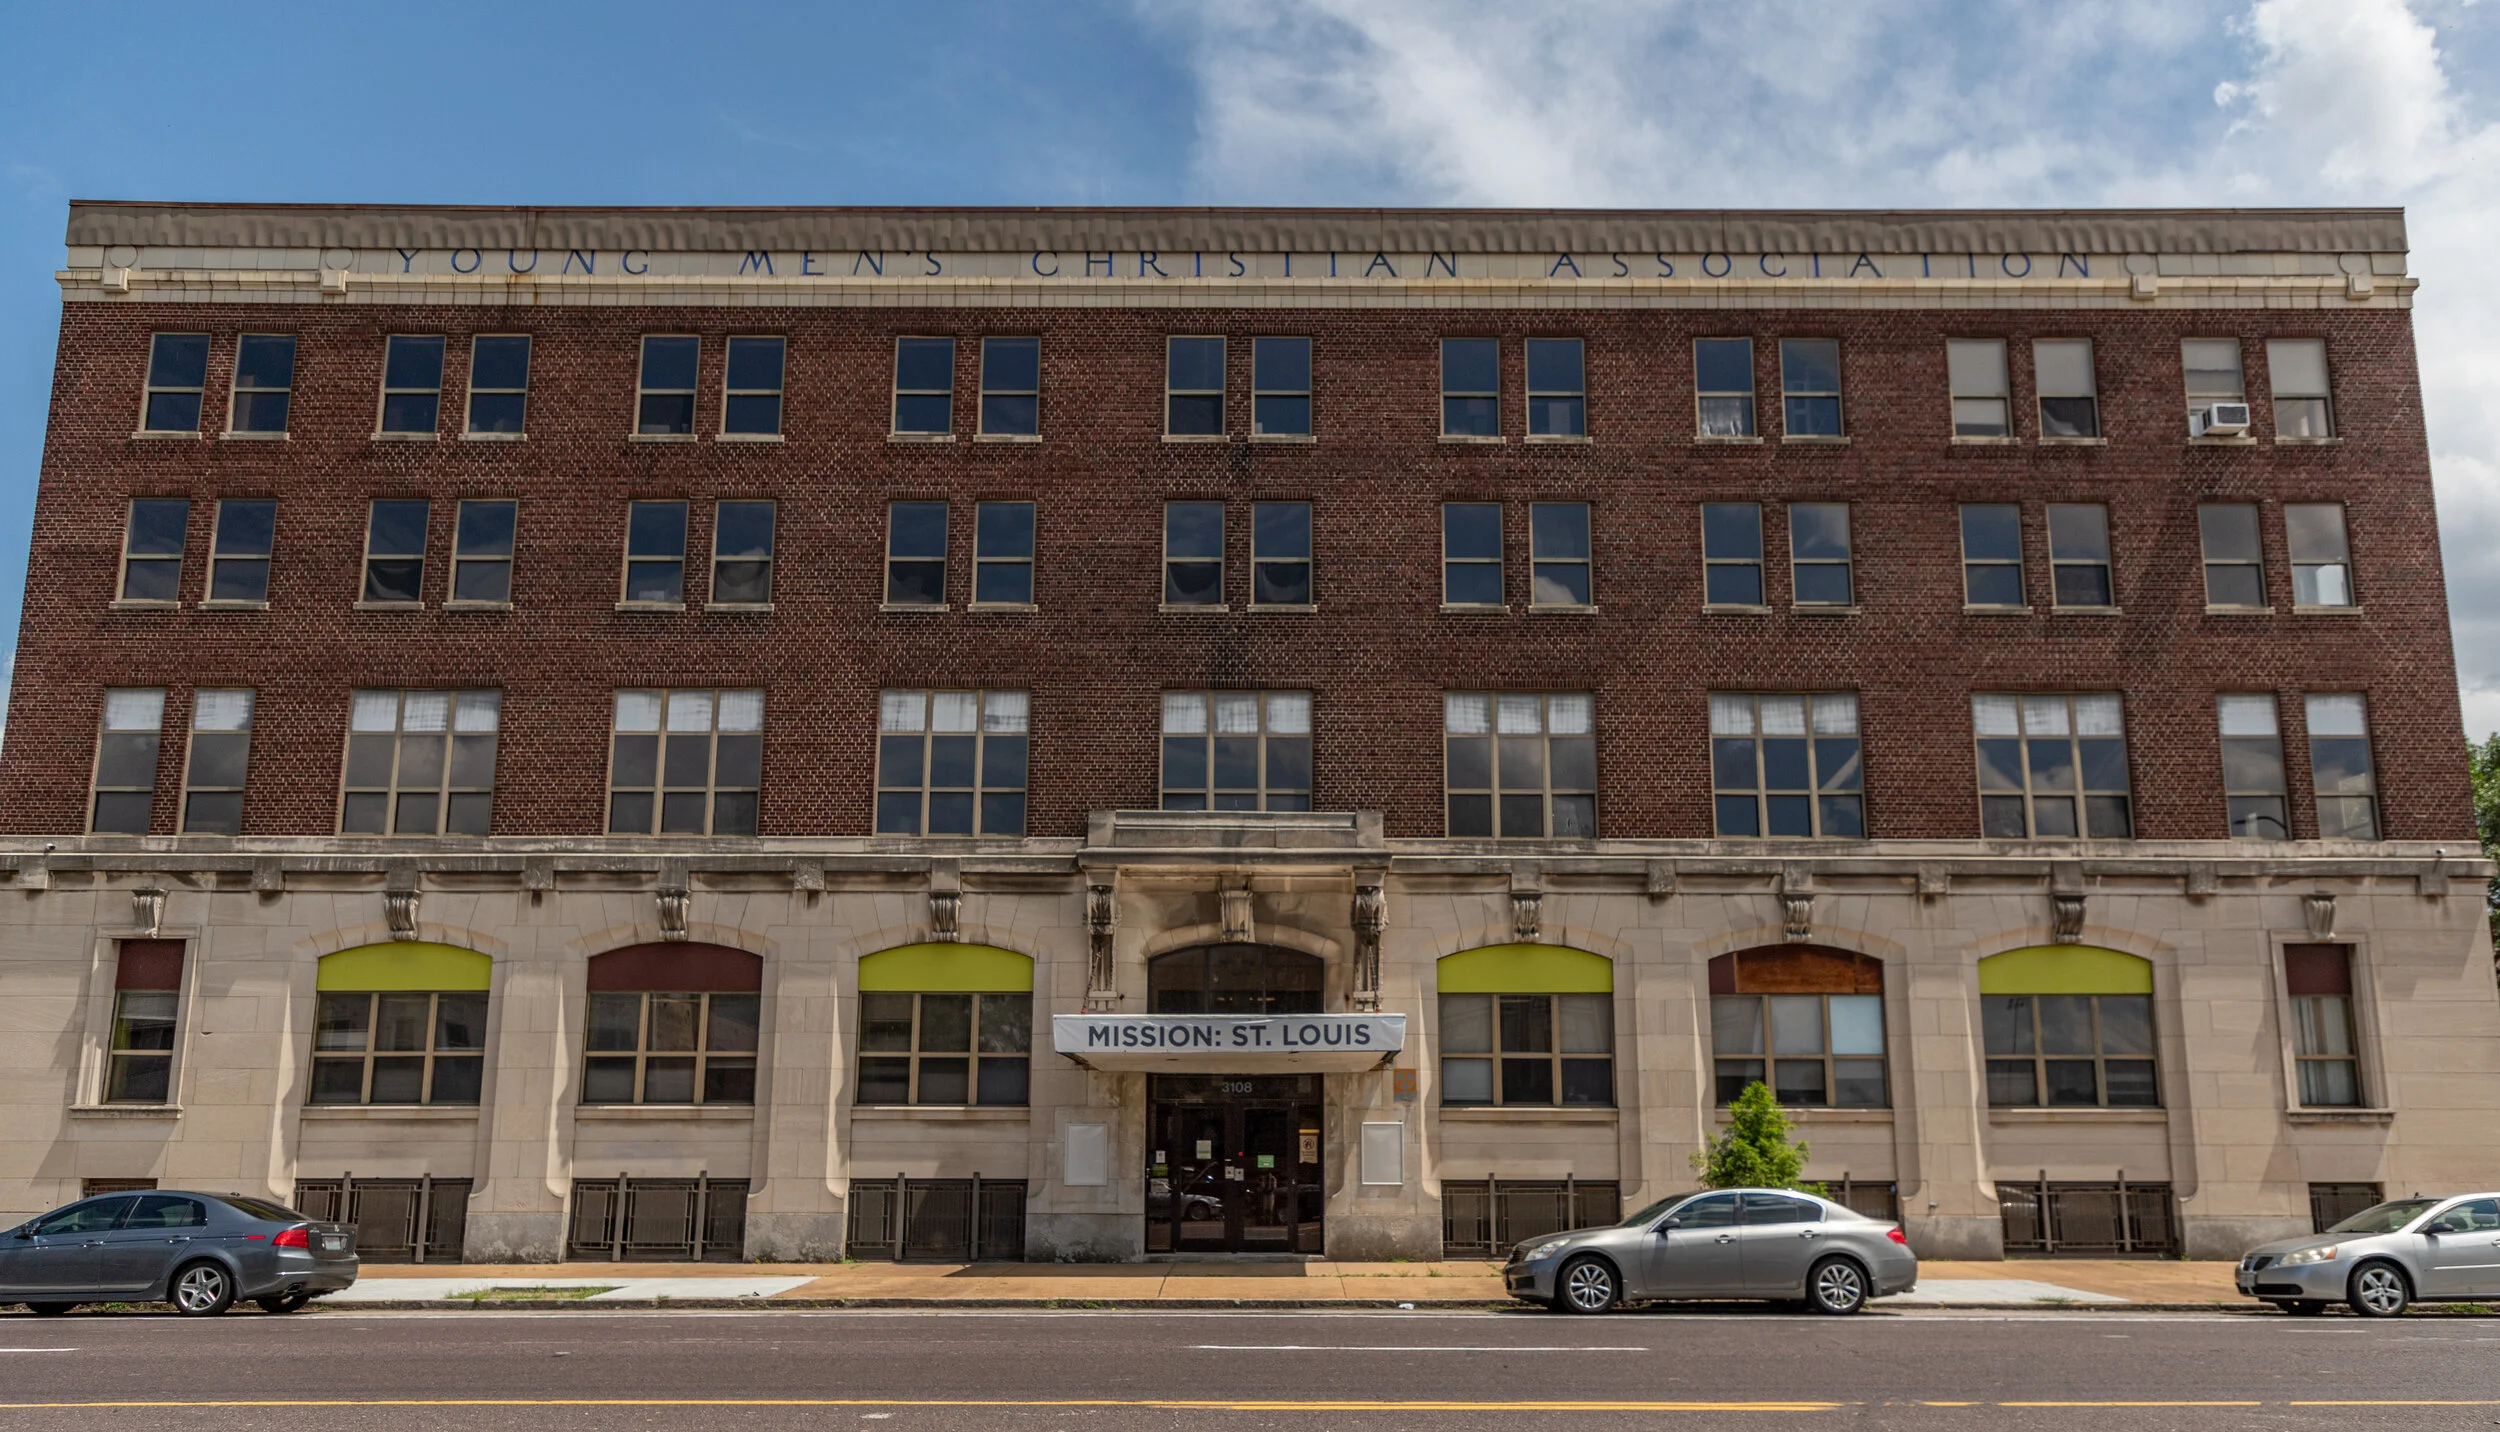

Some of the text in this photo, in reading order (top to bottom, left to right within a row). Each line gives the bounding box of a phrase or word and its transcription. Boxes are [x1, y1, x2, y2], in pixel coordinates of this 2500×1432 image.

[396, 248, 648, 275] YOUNG
[1088, 1024, 1371, 1047] MISSION: ST. LOUIS
[1221, 1081, 1253, 1093] 3108
